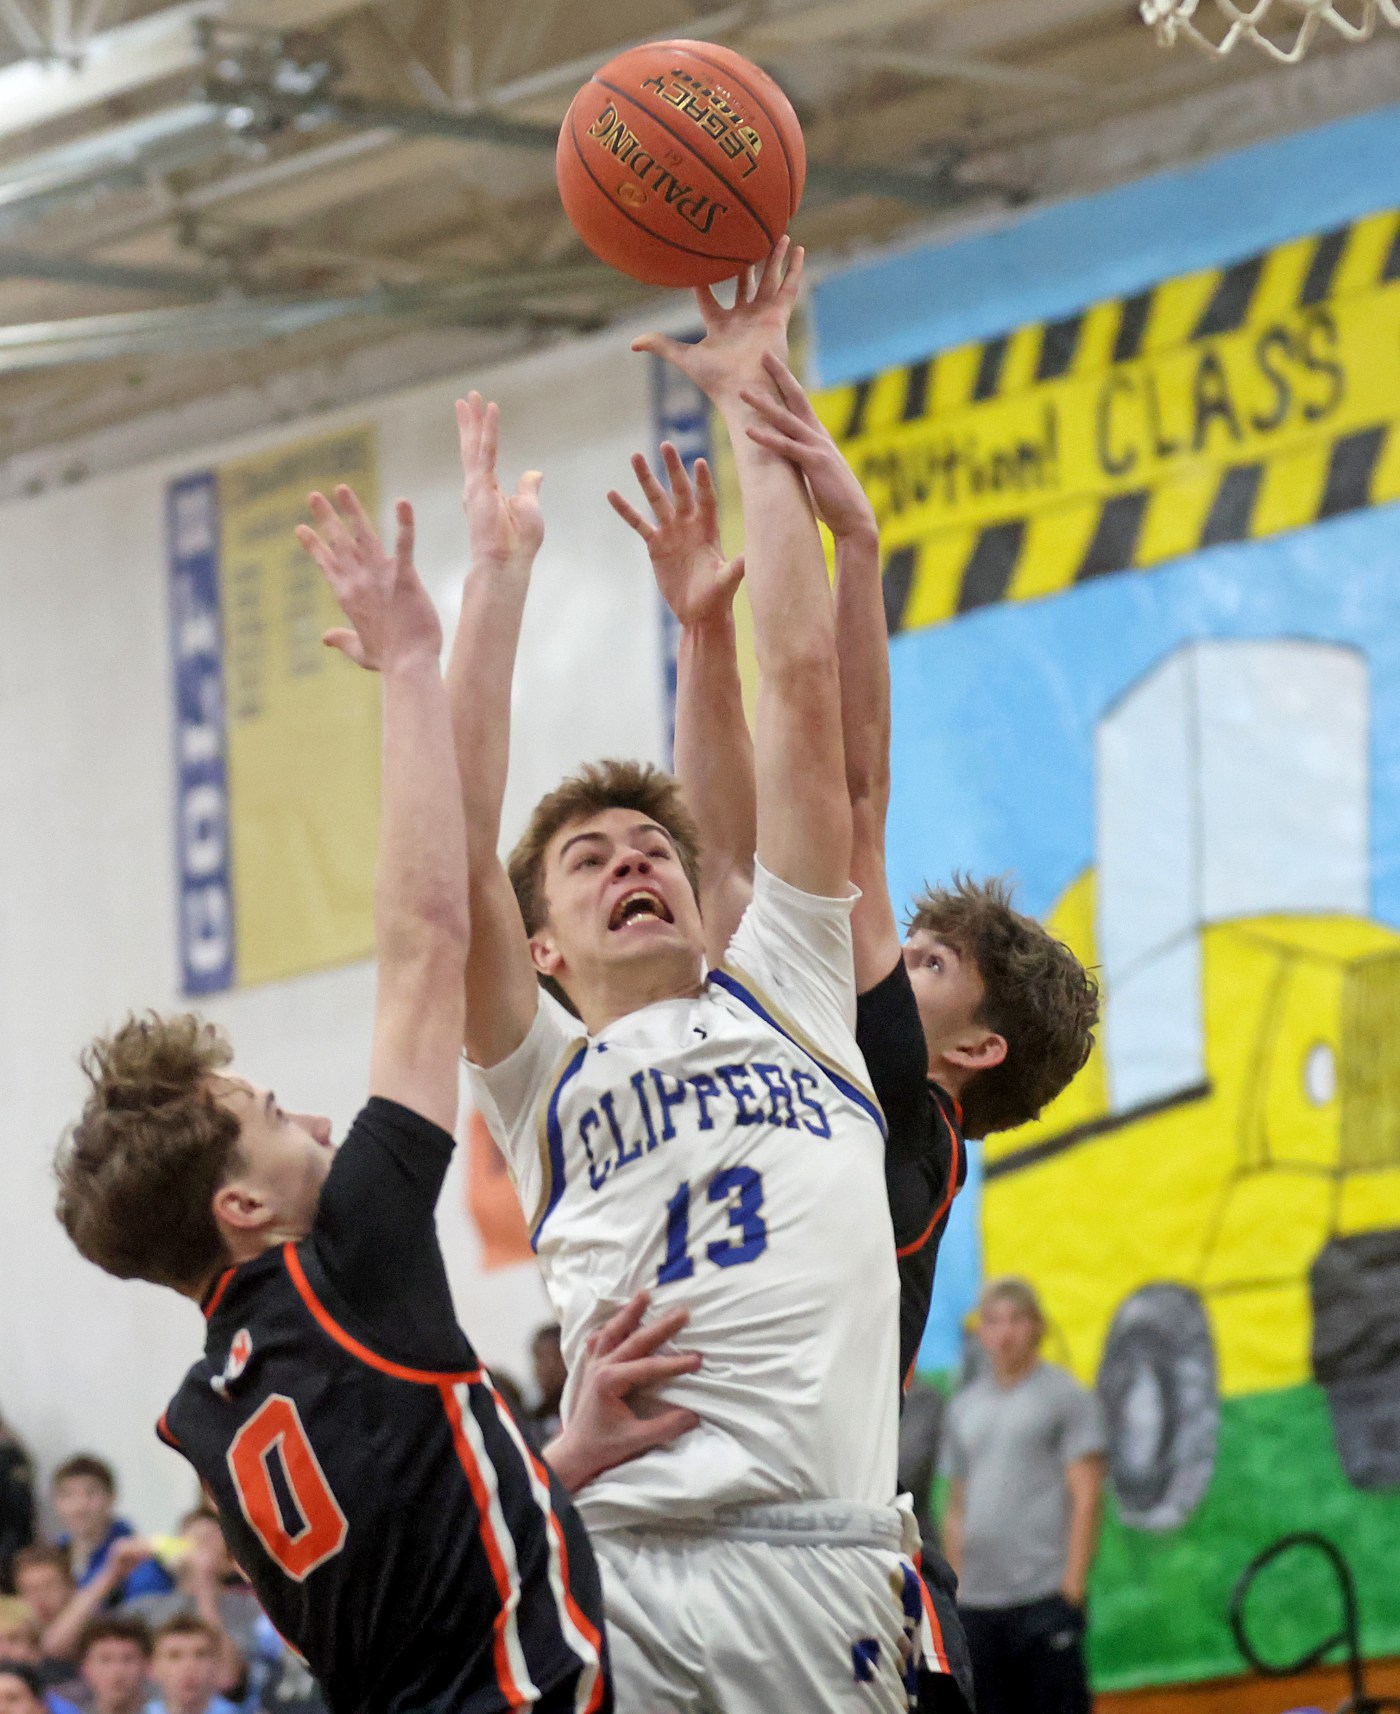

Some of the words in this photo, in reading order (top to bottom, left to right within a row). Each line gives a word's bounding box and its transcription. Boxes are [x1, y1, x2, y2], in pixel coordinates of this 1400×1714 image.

[586, 102, 729, 235] SPALDING
[640, 75, 758, 179] LEGACY
[1096, 306, 1347, 478] CLASS
[578, 1062, 832, 1192] CLIPPERS
[656, 1165, 768, 1287] 13
[226, 1393, 349, 1583] 0
